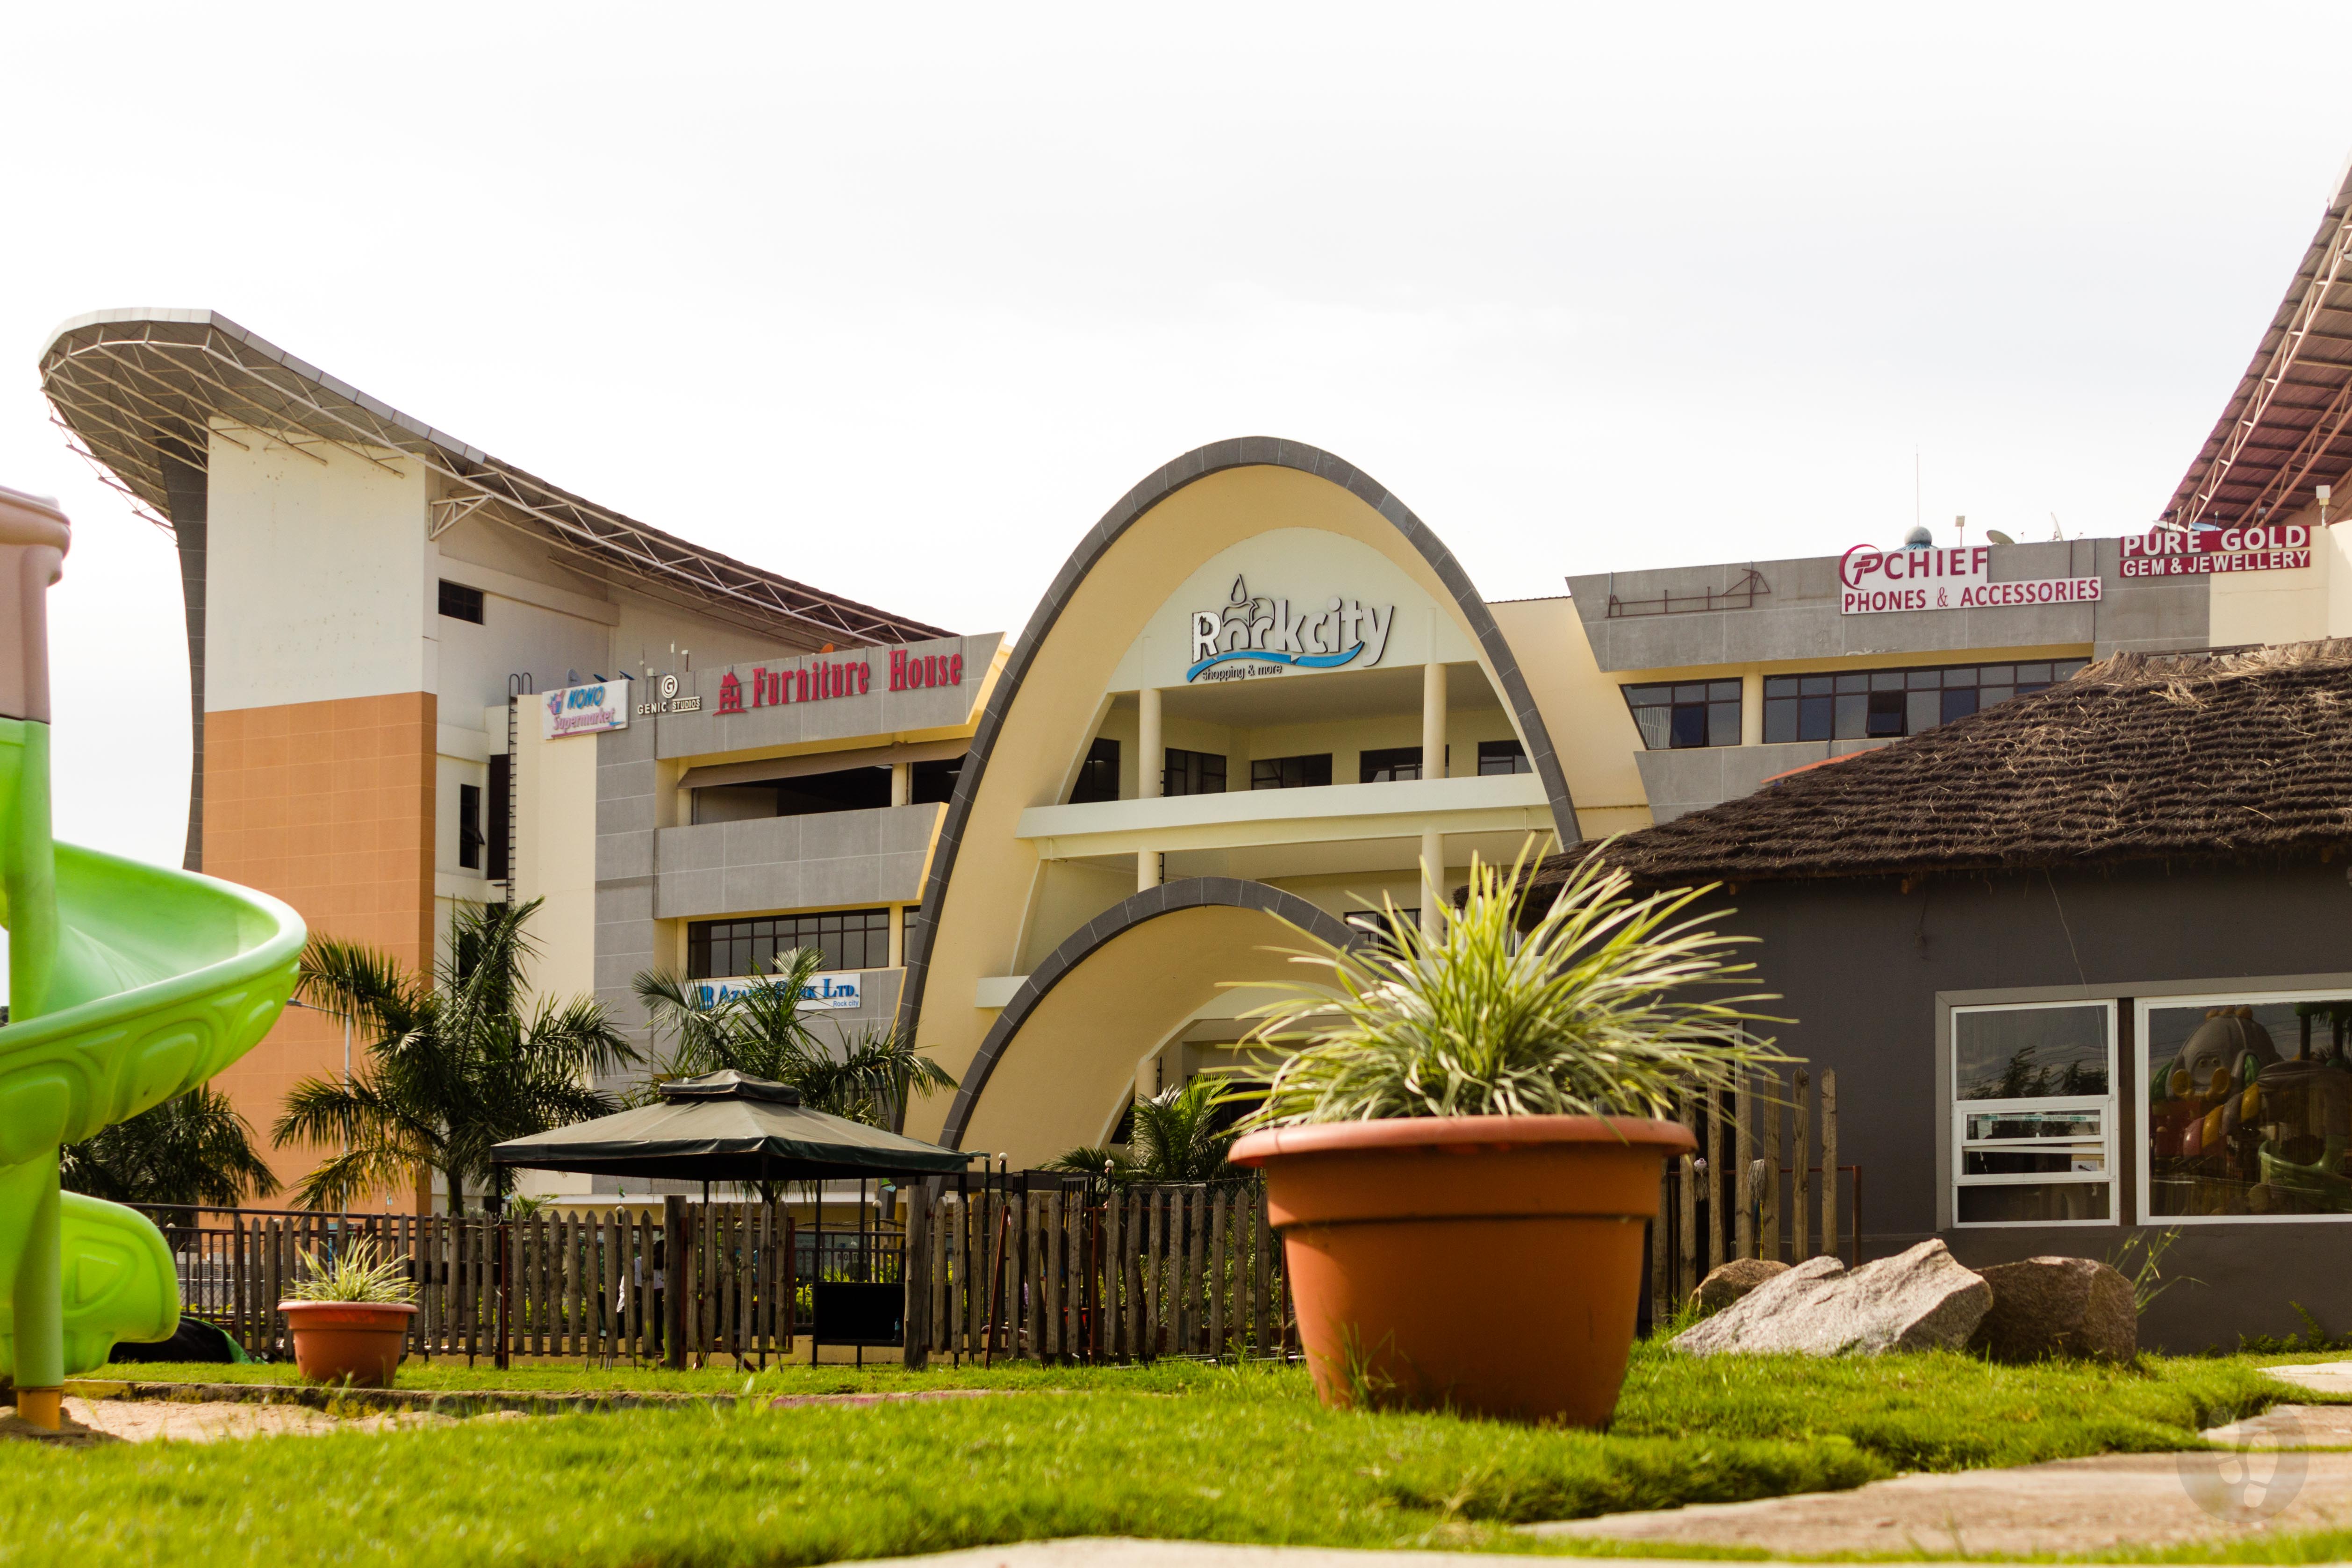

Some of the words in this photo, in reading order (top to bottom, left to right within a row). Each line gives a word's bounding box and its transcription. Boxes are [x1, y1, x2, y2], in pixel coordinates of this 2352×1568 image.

[2123, 531, 2201, 557] PURE
[2221, 525, 2306, 551] GOLD
[2123, 558, 2165, 577] GEM
[2170, 557, 2182, 574] &
[2188, 550, 2309, 574] JEWELLERY
[1844, 588, 1926, 613] PHONES
[1937, 587, 1949, 608] &
[1960, 579, 2099, 606] ACCESSORIES
[753, 660, 869, 708] Furniture
[889, 649, 962, 692] House
[1202, 666, 1245, 682] shopping
[1248, 665, 1255, 676] &
[1258, 664, 1283, 675] more
[637, 702, 667, 715] GENIC
[672, 699, 701, 710] STUDIOS
[553, 708, 616, 733] Supermarket
[849, 999, 859, 1009] city
